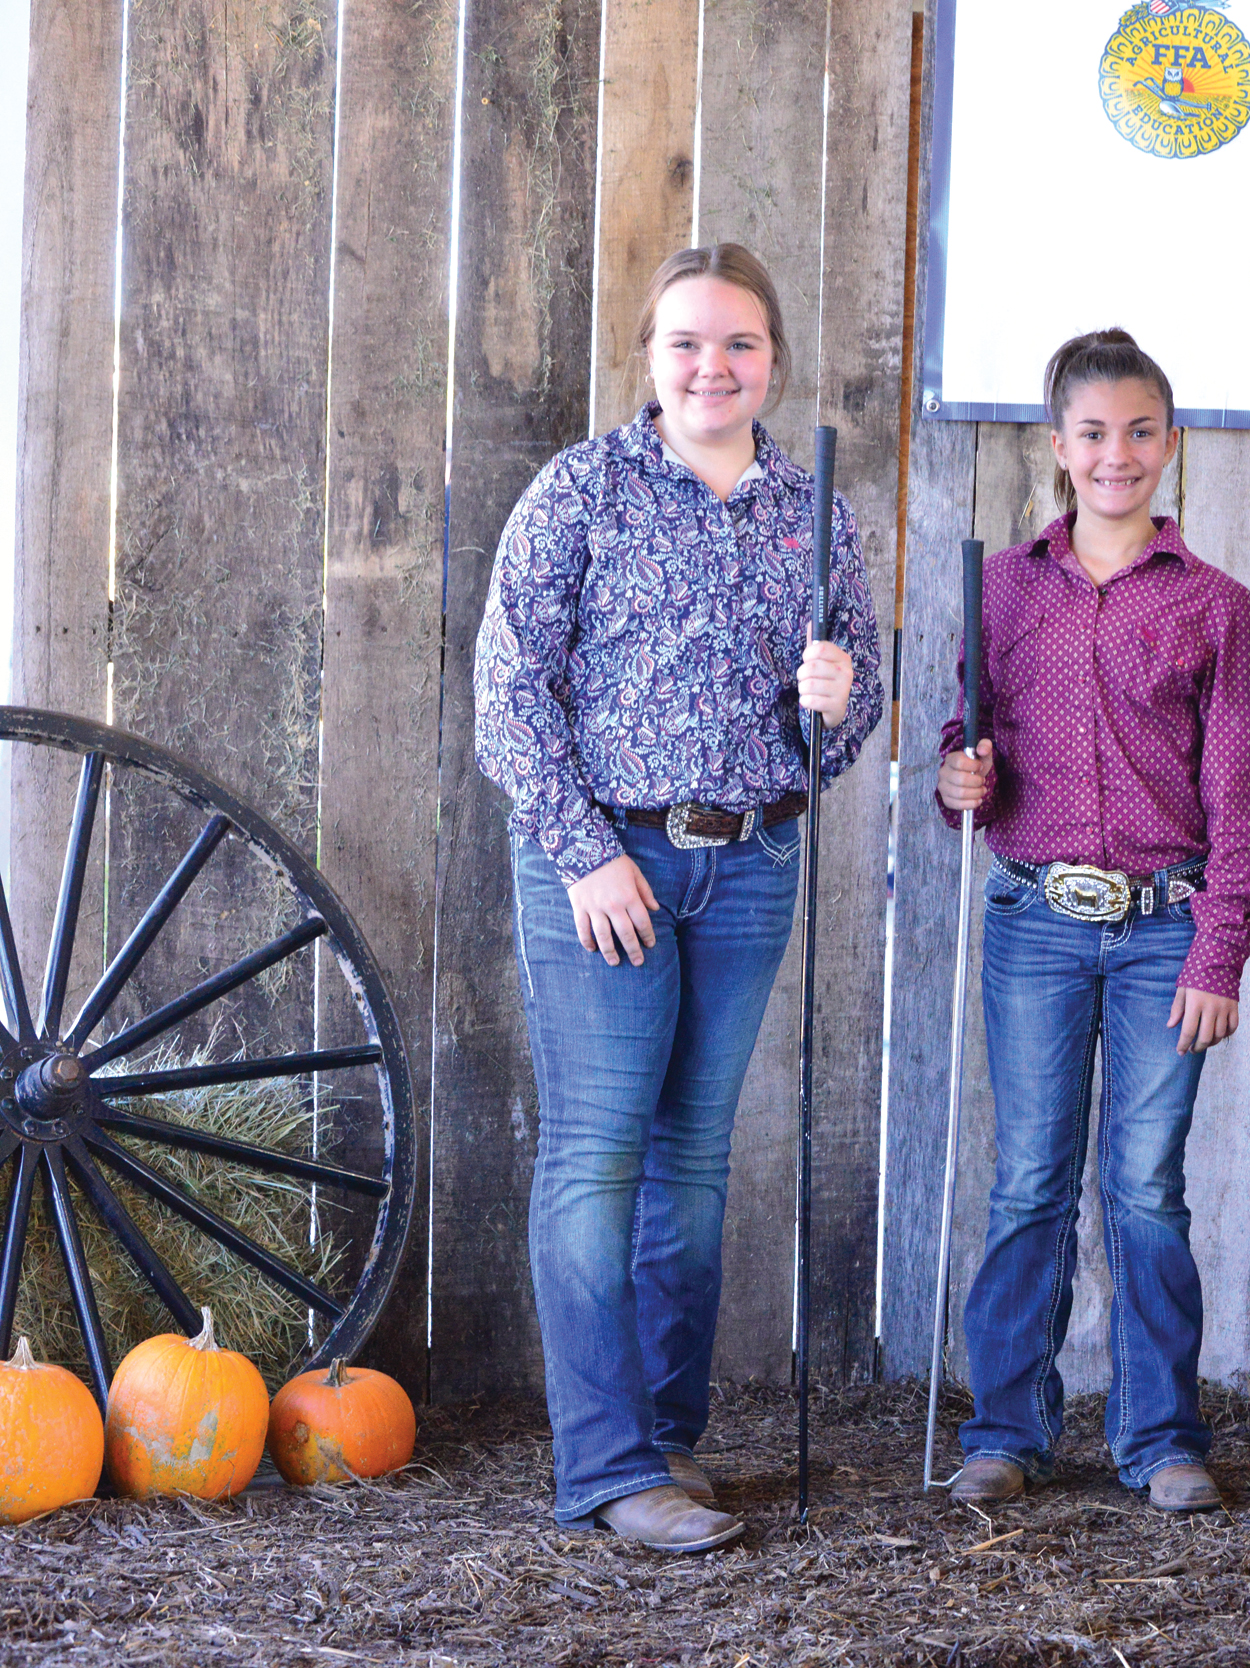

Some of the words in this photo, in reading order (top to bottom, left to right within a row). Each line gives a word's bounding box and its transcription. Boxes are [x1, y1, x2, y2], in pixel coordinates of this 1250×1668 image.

[1125, 25, 1234, 74] AGRICULTURAL
[1151, 43, 1211, 69] FFA
[1133, 104, 1225, 136] EDUCATION
